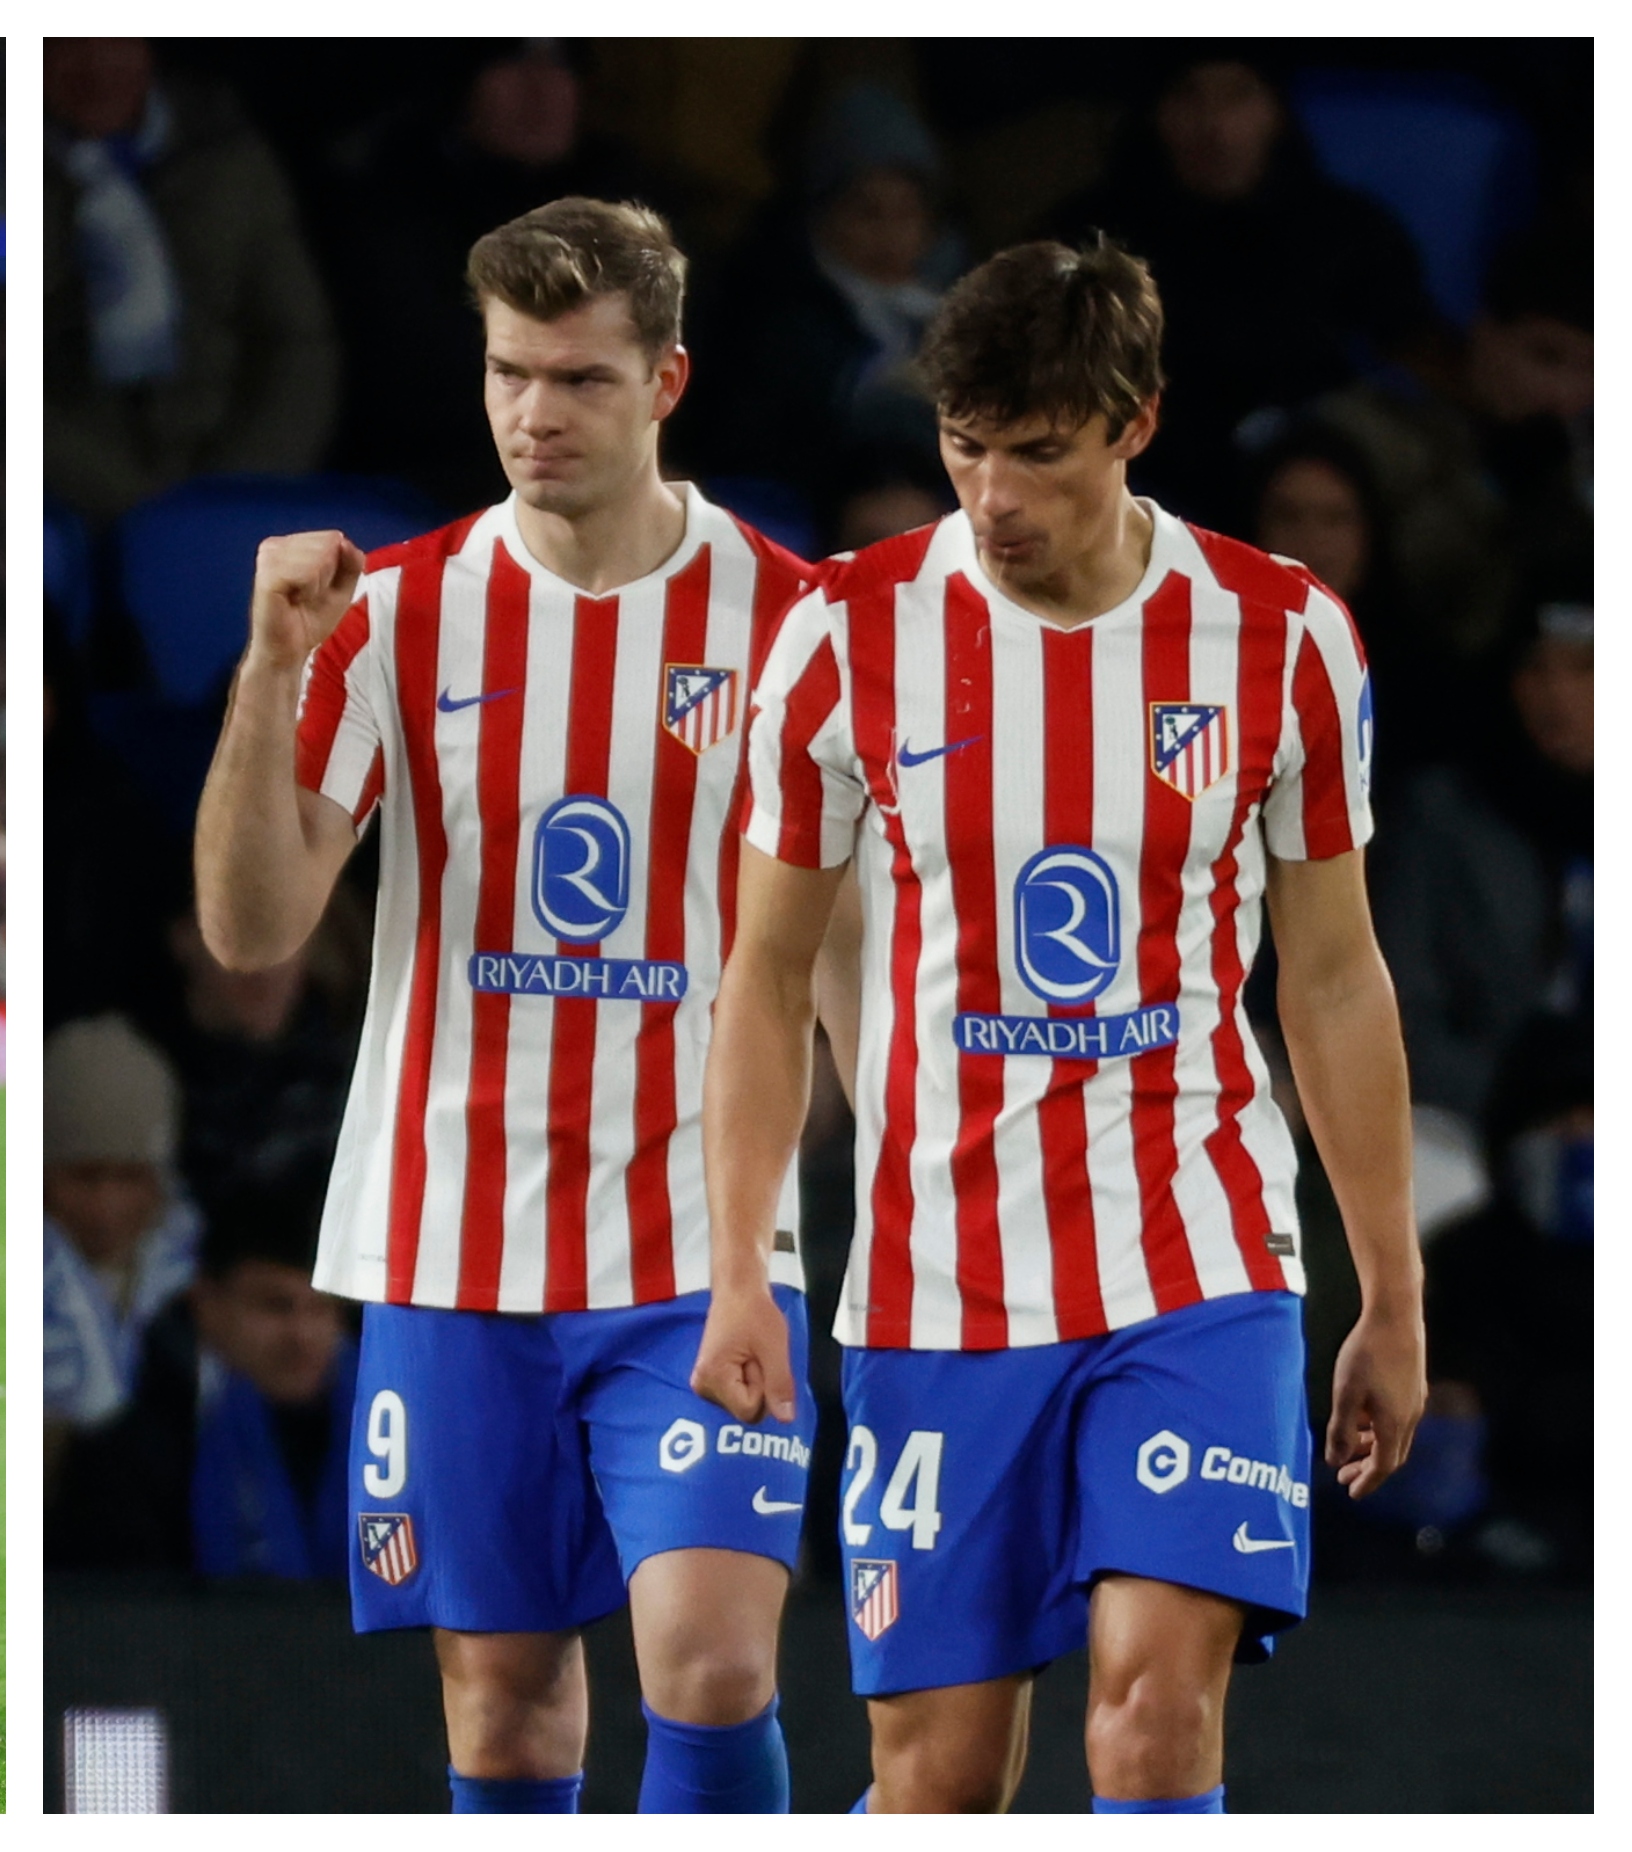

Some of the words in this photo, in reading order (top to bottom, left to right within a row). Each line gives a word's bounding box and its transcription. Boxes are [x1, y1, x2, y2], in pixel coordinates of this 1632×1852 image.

[477, 956, 609, 994] RIYADH
[619, 965, 680, 997] AIR
[963, 1017, 1107, 1053] RIYADH
[1119, 1008, 1174, 1051] AIR
[363, 1389, 407, 1499] 9
[717, 1424, 811, 1470] ComAv
[843, 1425, 944, 1550] 24
